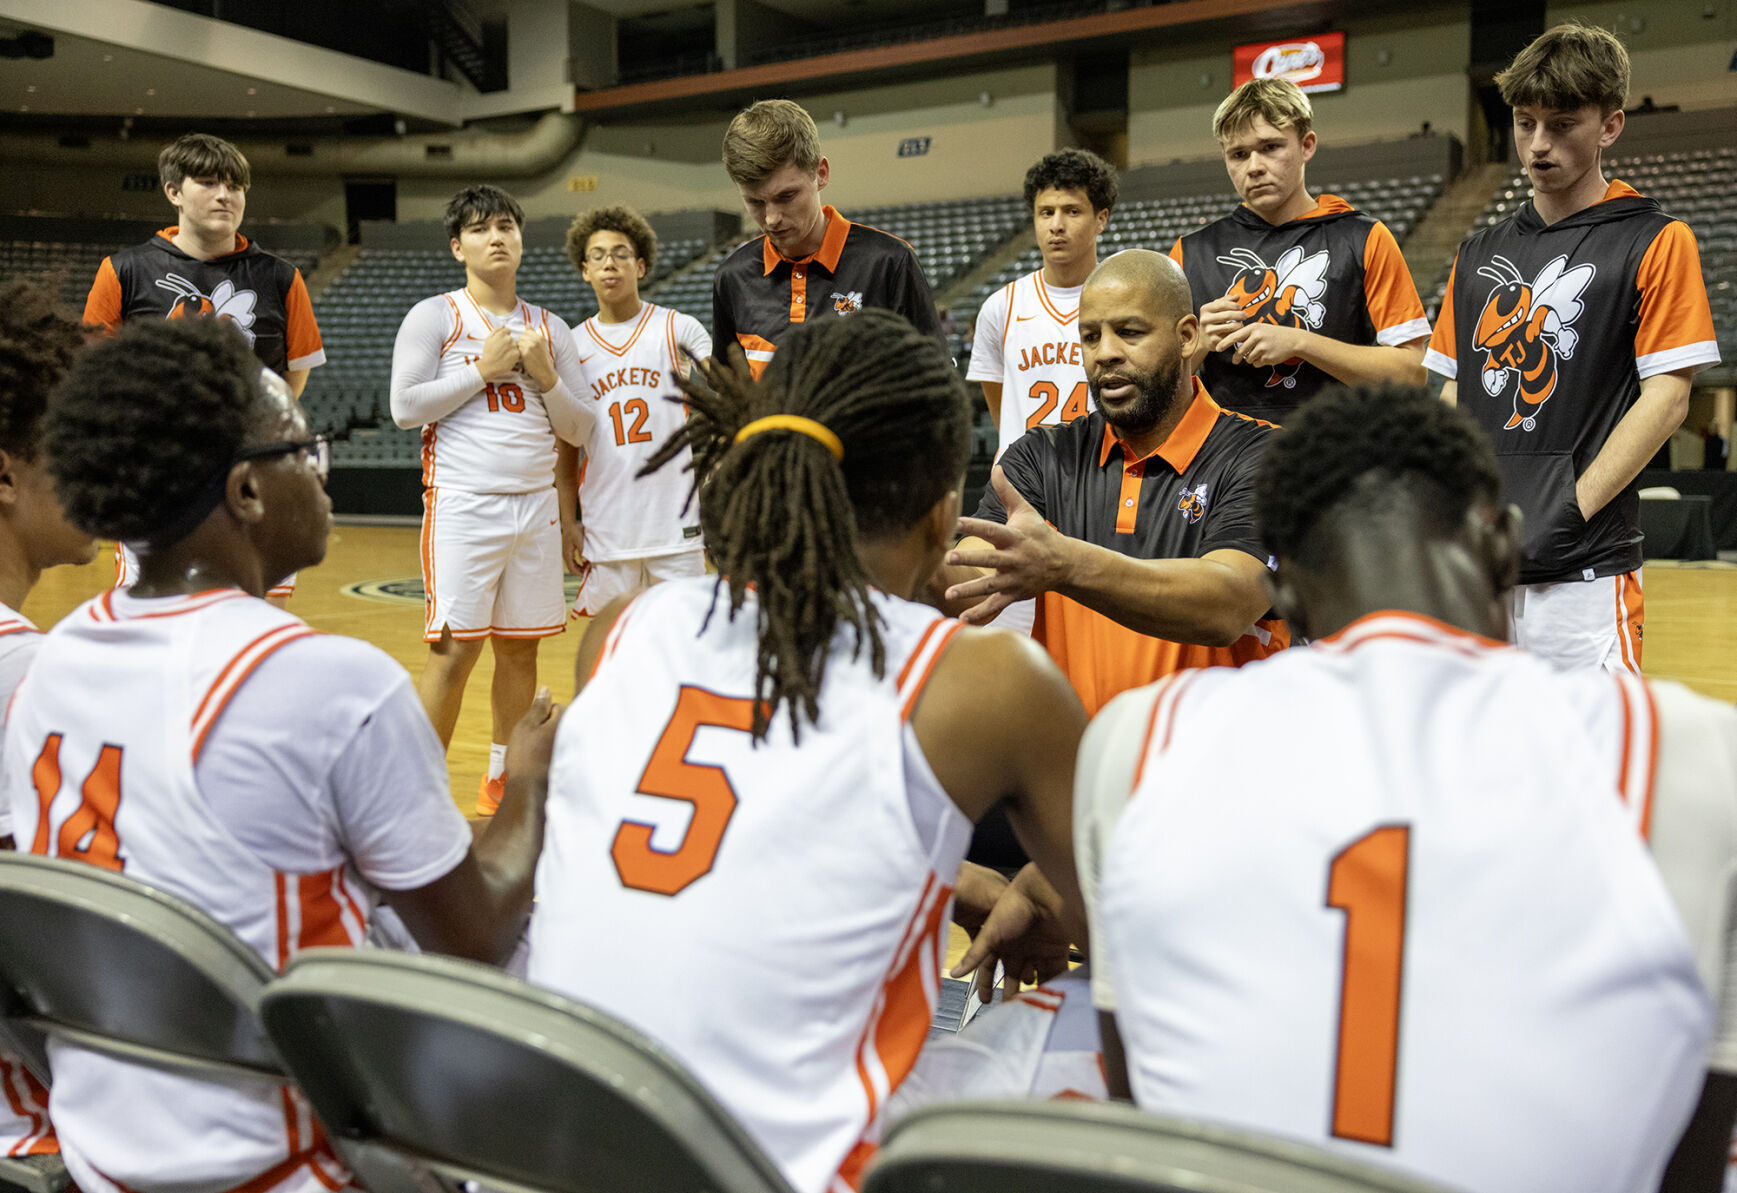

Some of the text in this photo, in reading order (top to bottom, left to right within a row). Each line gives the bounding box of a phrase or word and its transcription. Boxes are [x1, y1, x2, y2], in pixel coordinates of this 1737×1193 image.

[1018, 342, 1083, 371] JACKE
[1500, 340, 1526, 369] TJ
[482, 382, 526, 413] 10
[591, 367, 661, 401] JACKETS
[1025, 380, 1090, 431] 24
[608, 397, 653, 447] 12
[30, 732, 126, 872] 14
[610, 684, 774, 897] 5
[1325, 824, 1411, 1147] 1
